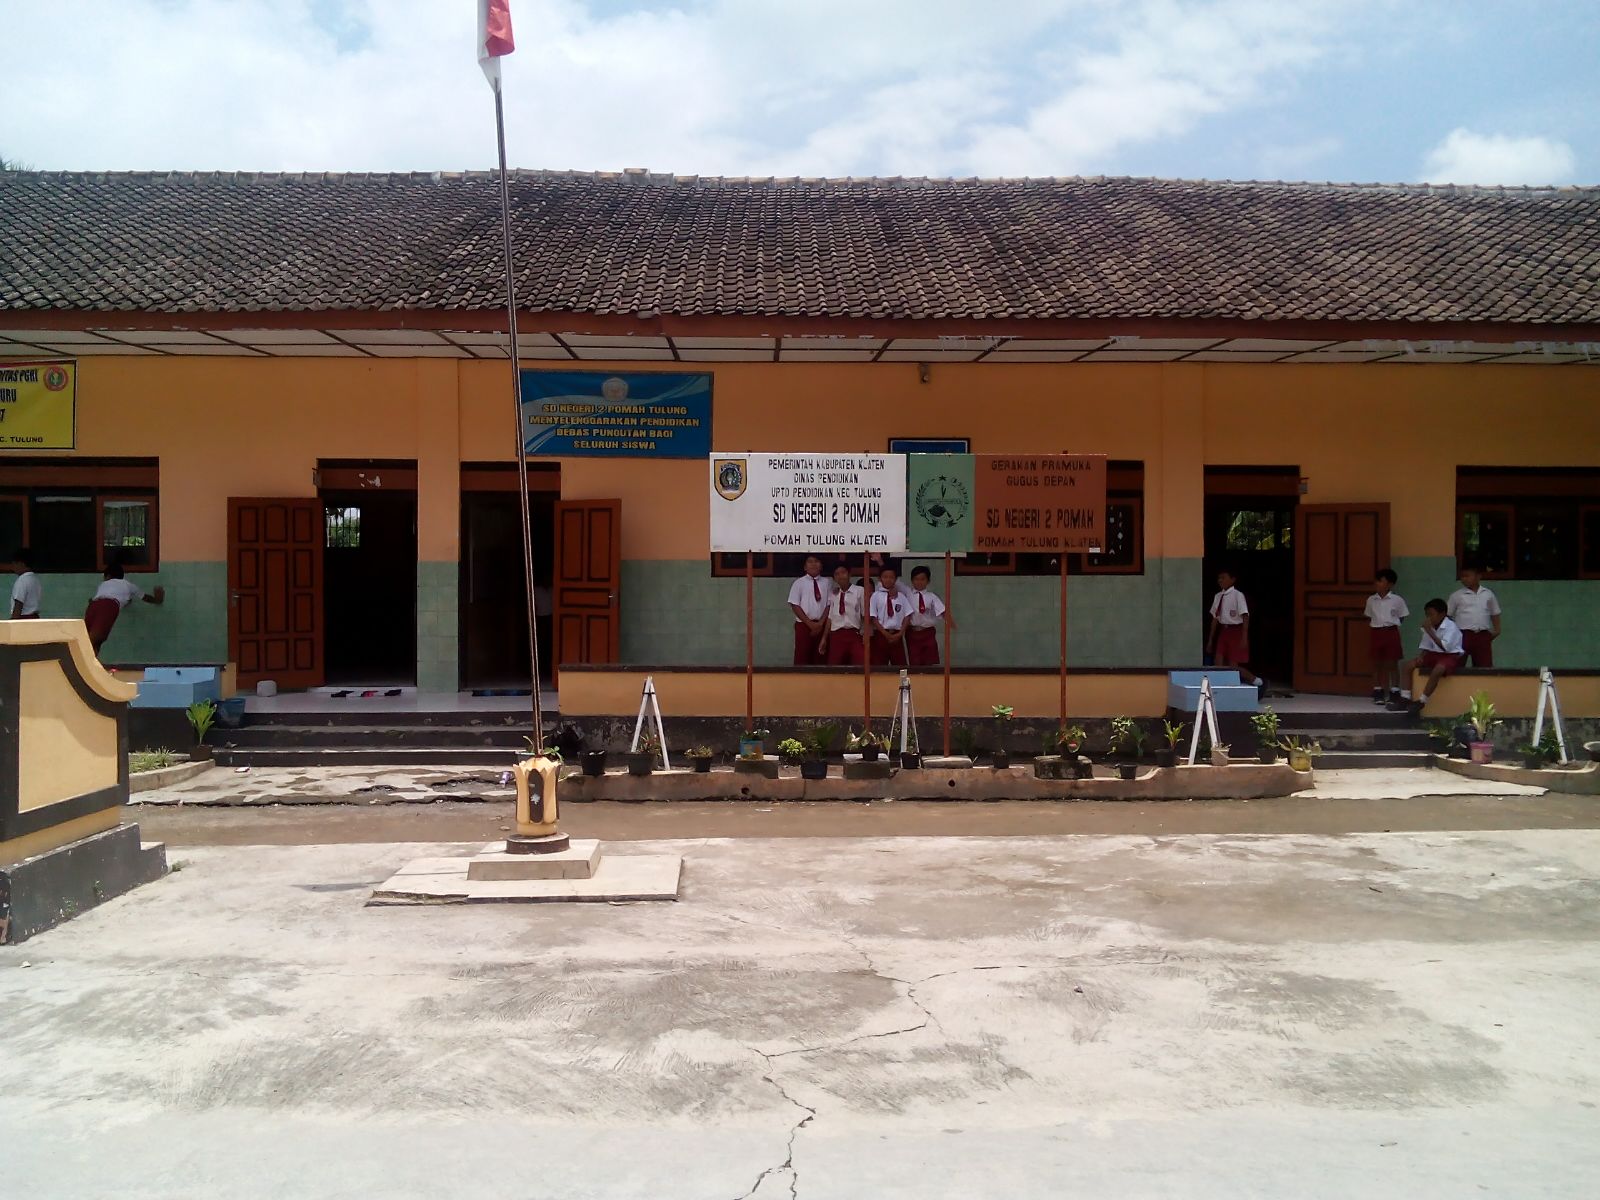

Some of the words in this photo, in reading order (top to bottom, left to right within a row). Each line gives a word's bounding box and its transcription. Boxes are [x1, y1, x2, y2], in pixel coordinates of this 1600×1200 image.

[19, 368, 38, 382] PGRI
[542, 403, 557, 413] SD
[559, 404, 595, 413] NEGERI
[597, 405, 607, 414] 2
[608, 405, 645, 414] POMAH
[649, 406, 688, 415] TULUNG
[529, 415, 637, 426] MENYELENGGARAKAN
[640, 417, 700, 427] PENDIDIKAN
[555, 428, 590, 437] BEBAS
[592, 428, 647, 438] PUNGUTAN
[649, 429, 673, 438] BAGI
[573, 440, 619, 450] SELURUH
[621, 441, 656, 450] SISWA
[768, 459, 813, 470] PEMERINTAH
[816, 459, 855, 470] KABUPATEN
[858, 459, 885, 470] KLATEN
[991, 460, 1037, 471] GERAKAN
[1042, 460, 1091, 471] PRAMUKA
[794, 472, 815, 484] DINAS
[818, 473, 859, 484] PENDIDIKAN
[1006, 475, 1039, 487] GUGUS
[1044, 476, 1076, 487] DEPAN
[792, 487, 833, 498] PENDIDIKAN
[854, 487, 882, 498] TULUNG
[773, 503, 786, 523] SD
[791, 502, 827, 523] NEGERI
[831, 502, 839, 523] 2
[843, 502, 880, 523] POMAH
[986, 509, 999, 529] SD
[1004, 509, 1040, 529] NEGERI
[1045, 509, 1051, 529] 2
[1056, 509, 1094, 529] POMAH
[764, 534, 801, 546] POMAH
[806, 534, 845, 546] TULUNG
[850, 534, 888, 546] KLATEN
[978, 536, 1015, 548] POMAH
[1020, 536, 1059, 548] TULUNG
[1064, 536, 1101, 548] KLATEN
